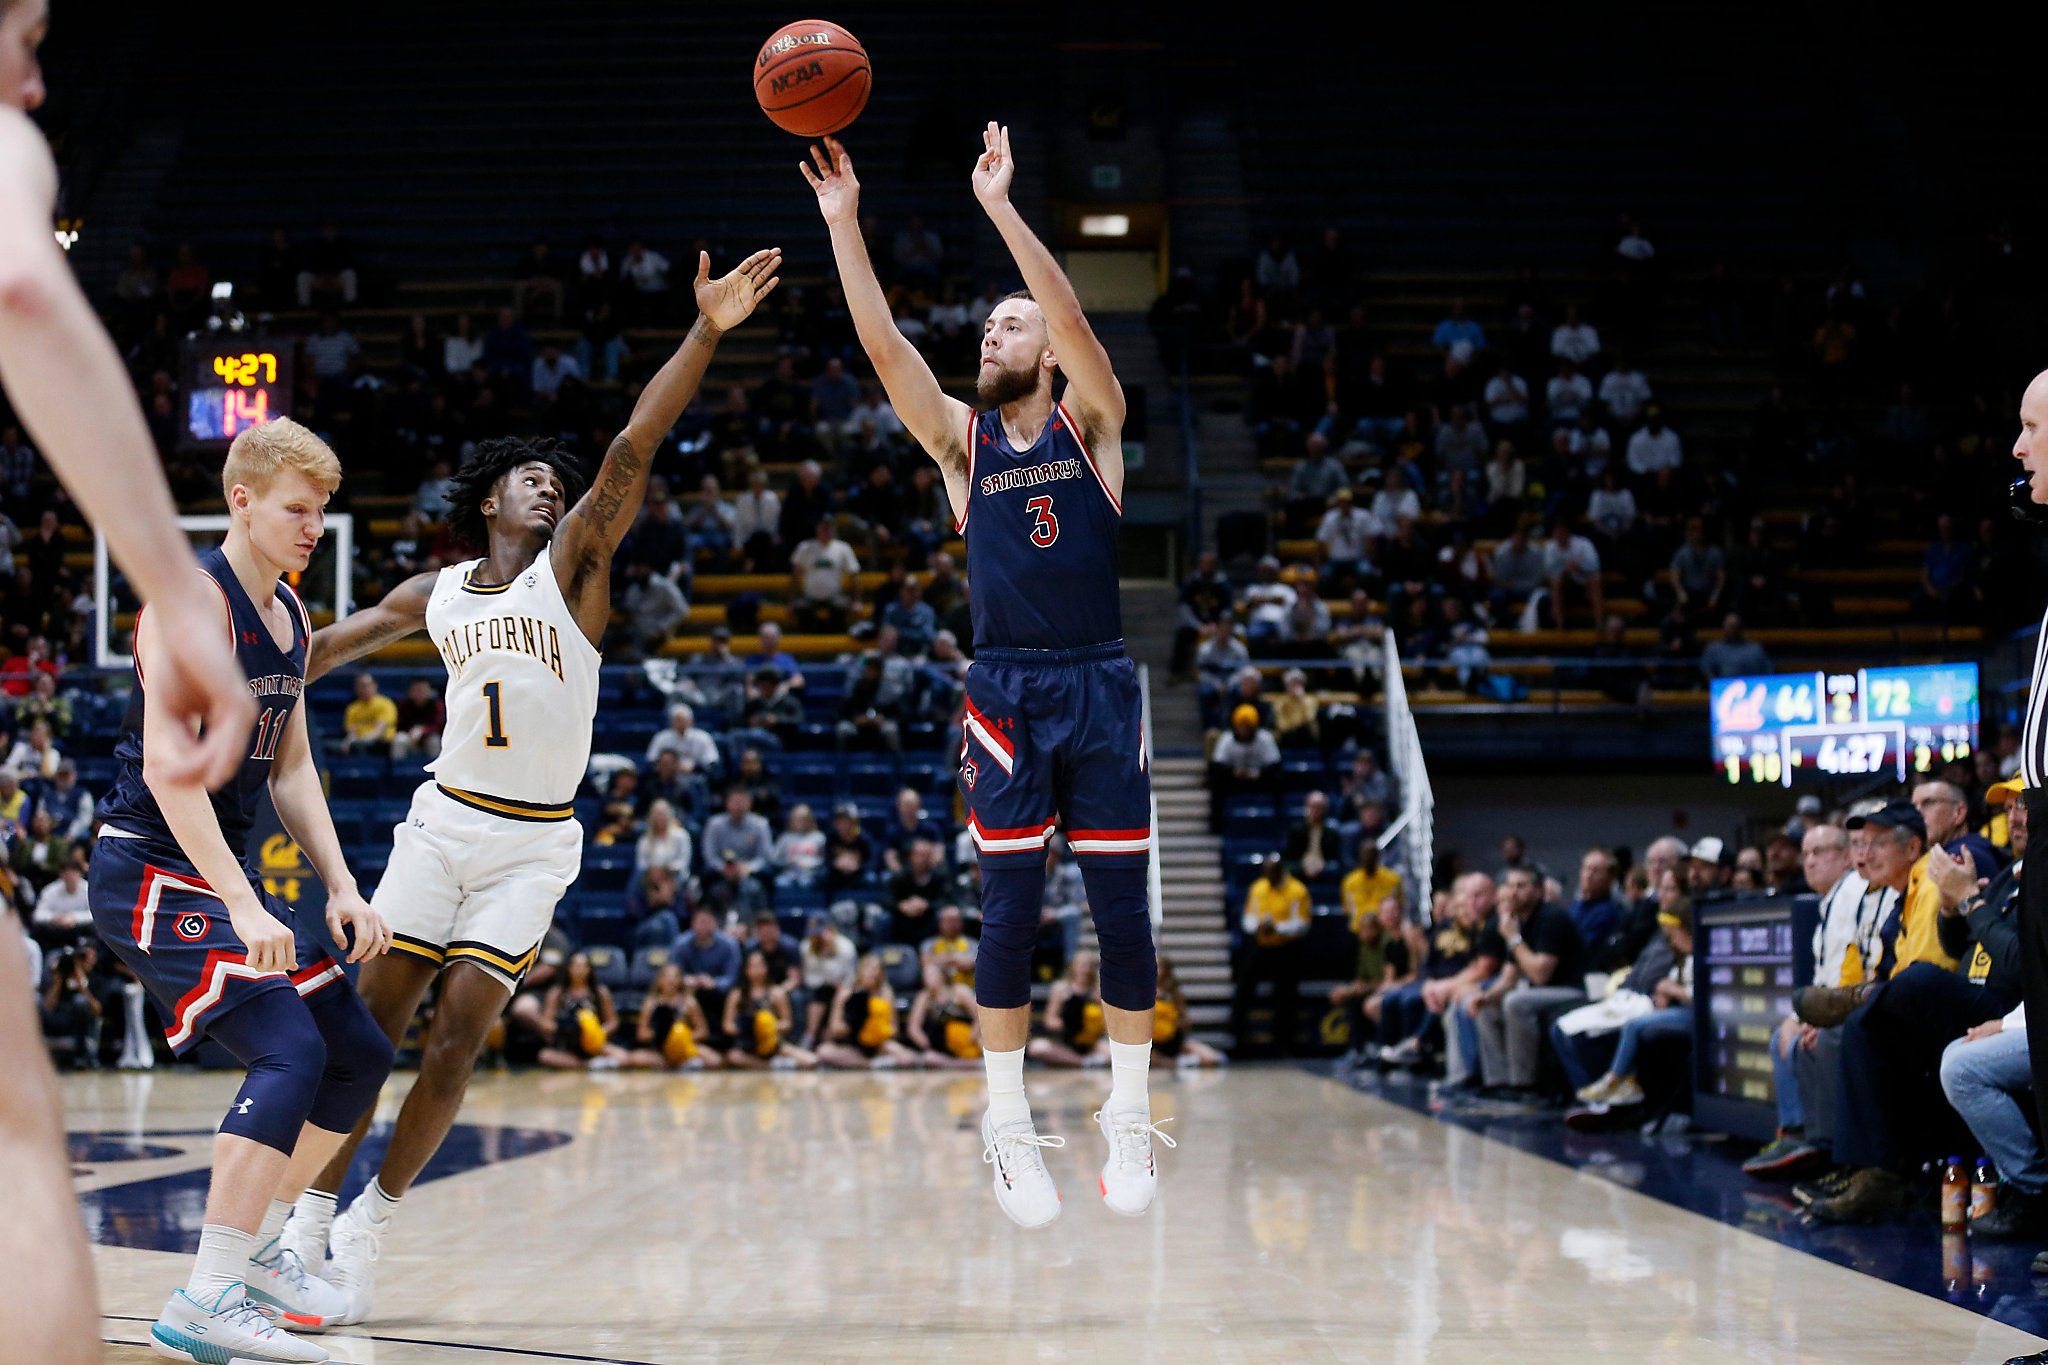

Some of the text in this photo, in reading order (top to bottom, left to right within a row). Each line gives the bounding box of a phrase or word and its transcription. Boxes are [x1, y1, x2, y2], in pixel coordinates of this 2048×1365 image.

[758, 33, 831, 67] Wilson
[771, 61, 824, 95] NCAA
[213, 353, 277, 386] 4:27
[224, 389, 267, 437] 14
[1026, 495, 1059, 548] 3
[442, 616, 565, 684] ALIFORNIA
[482, 680, 510, 748] 1
[1869, 678, 1912, 717] 72
[250, 707, 287, 760] 11
[1816, 733, 1887, 775] 4:27
